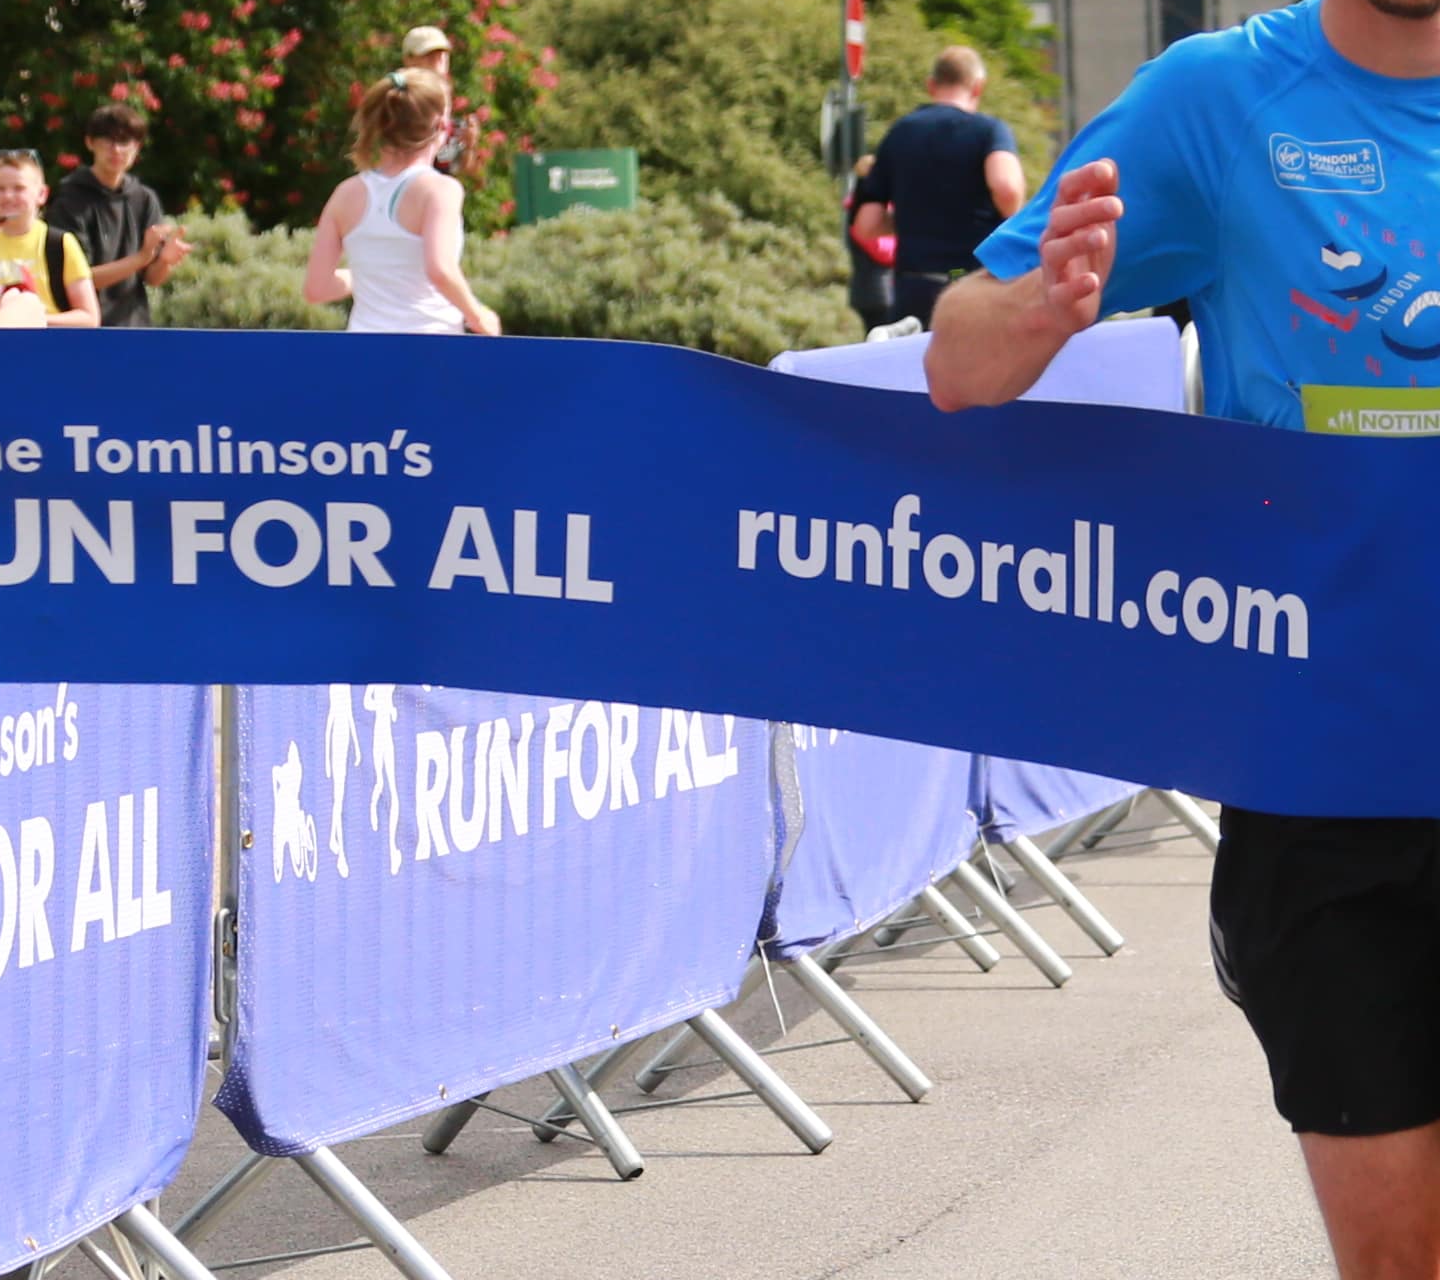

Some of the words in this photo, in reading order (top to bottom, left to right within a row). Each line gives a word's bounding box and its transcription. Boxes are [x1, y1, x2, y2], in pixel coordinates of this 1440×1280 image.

[1308, 151, 1357, 165] LONDON
[1310, 161, 1376, 175] MARATHON
[1366, 271, 1422, 322] LONDON
[63, 424, 433, 477] Tomlinson's
[170, 499, 396, 588] FOR
[428, 505, 614, 603] ALL
[737, 493, 1309, 659] runforall.com
[413, 712, 535, 863] RUN
[541, 699, 641, 830] FOR
[654, 708, 740, 801] ALL
[71, 786, 172, 952] ALL
